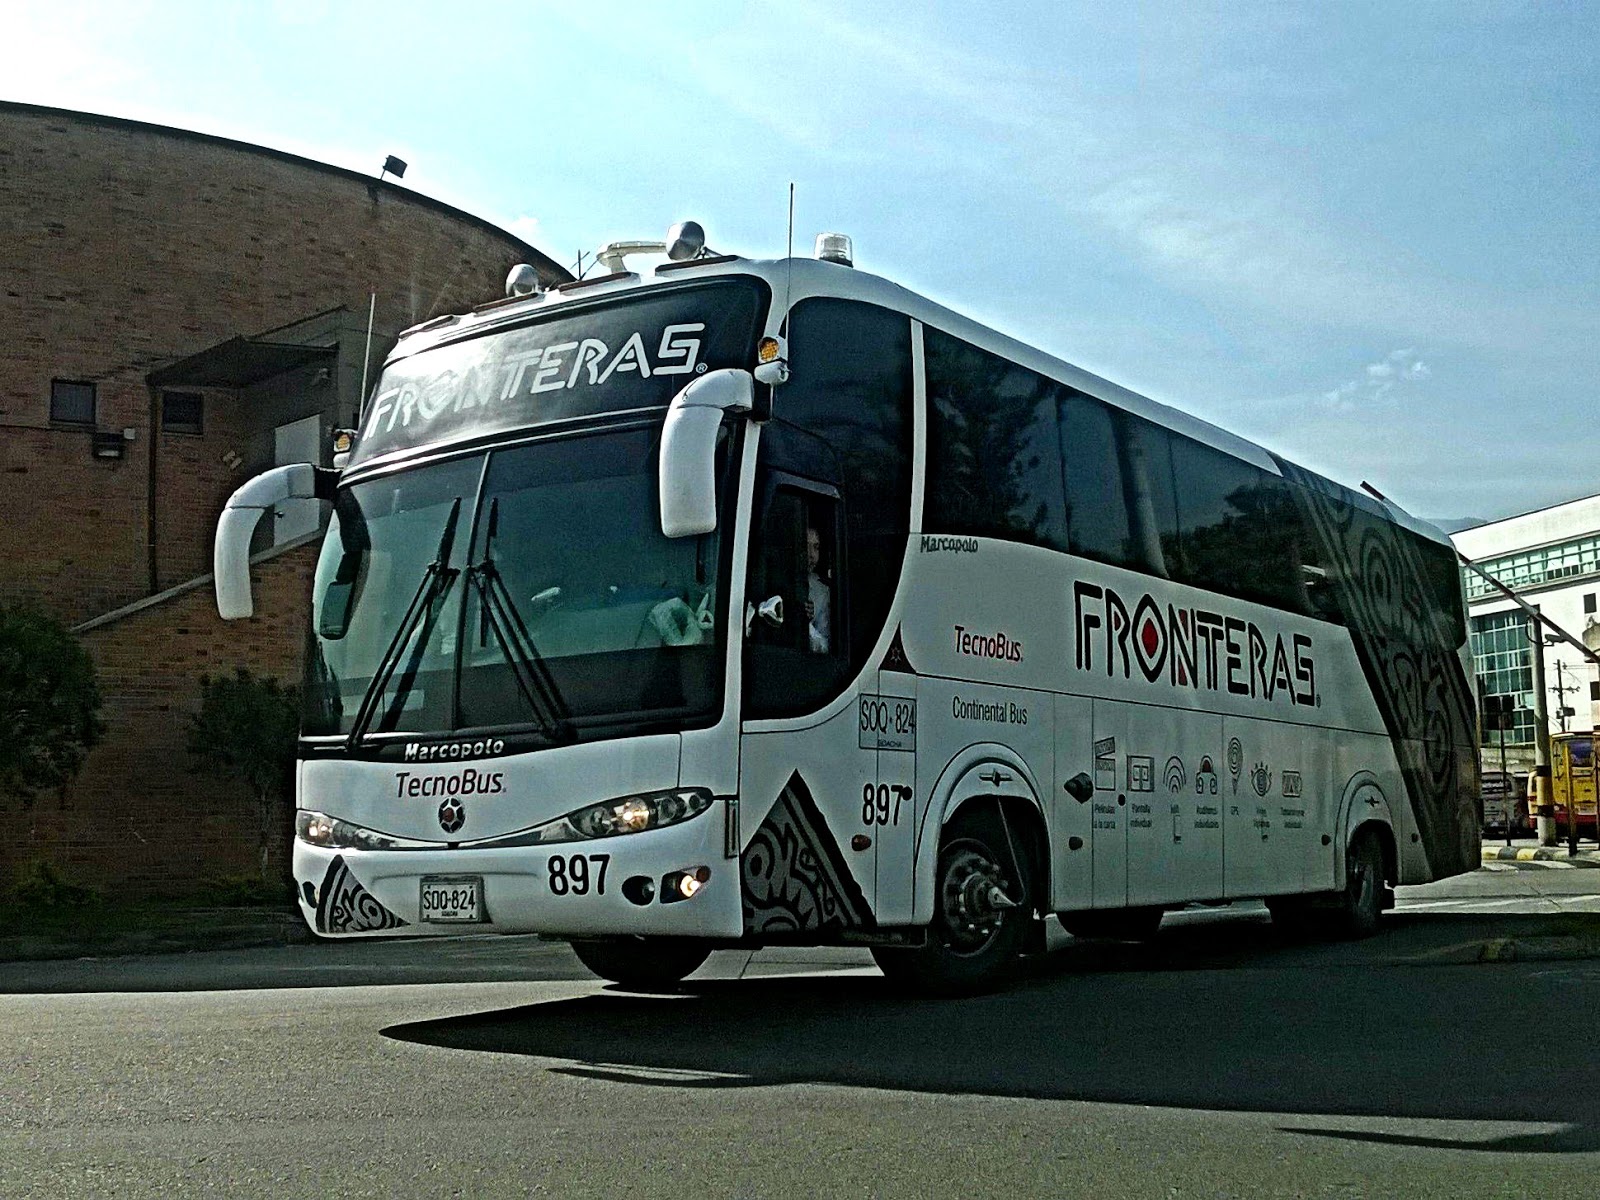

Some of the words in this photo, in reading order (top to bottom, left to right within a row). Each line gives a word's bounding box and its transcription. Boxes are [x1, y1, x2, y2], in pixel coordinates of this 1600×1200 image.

[920, 535, 979, 553] Marcopolo
[954, 625, 1022, 662] TecnoBus
[1073, 580, 1316, 707] FRONTERAS
[952, 695, 1007, 723] Continental
[1009, 702, 1028, 725] Bus
[404, 738, 505, 761] Marcopolo
[395, 768, 504, 798] TecnoBus
[862, 782, 904, 826] 897
[547, 853, 611, 896] 897
